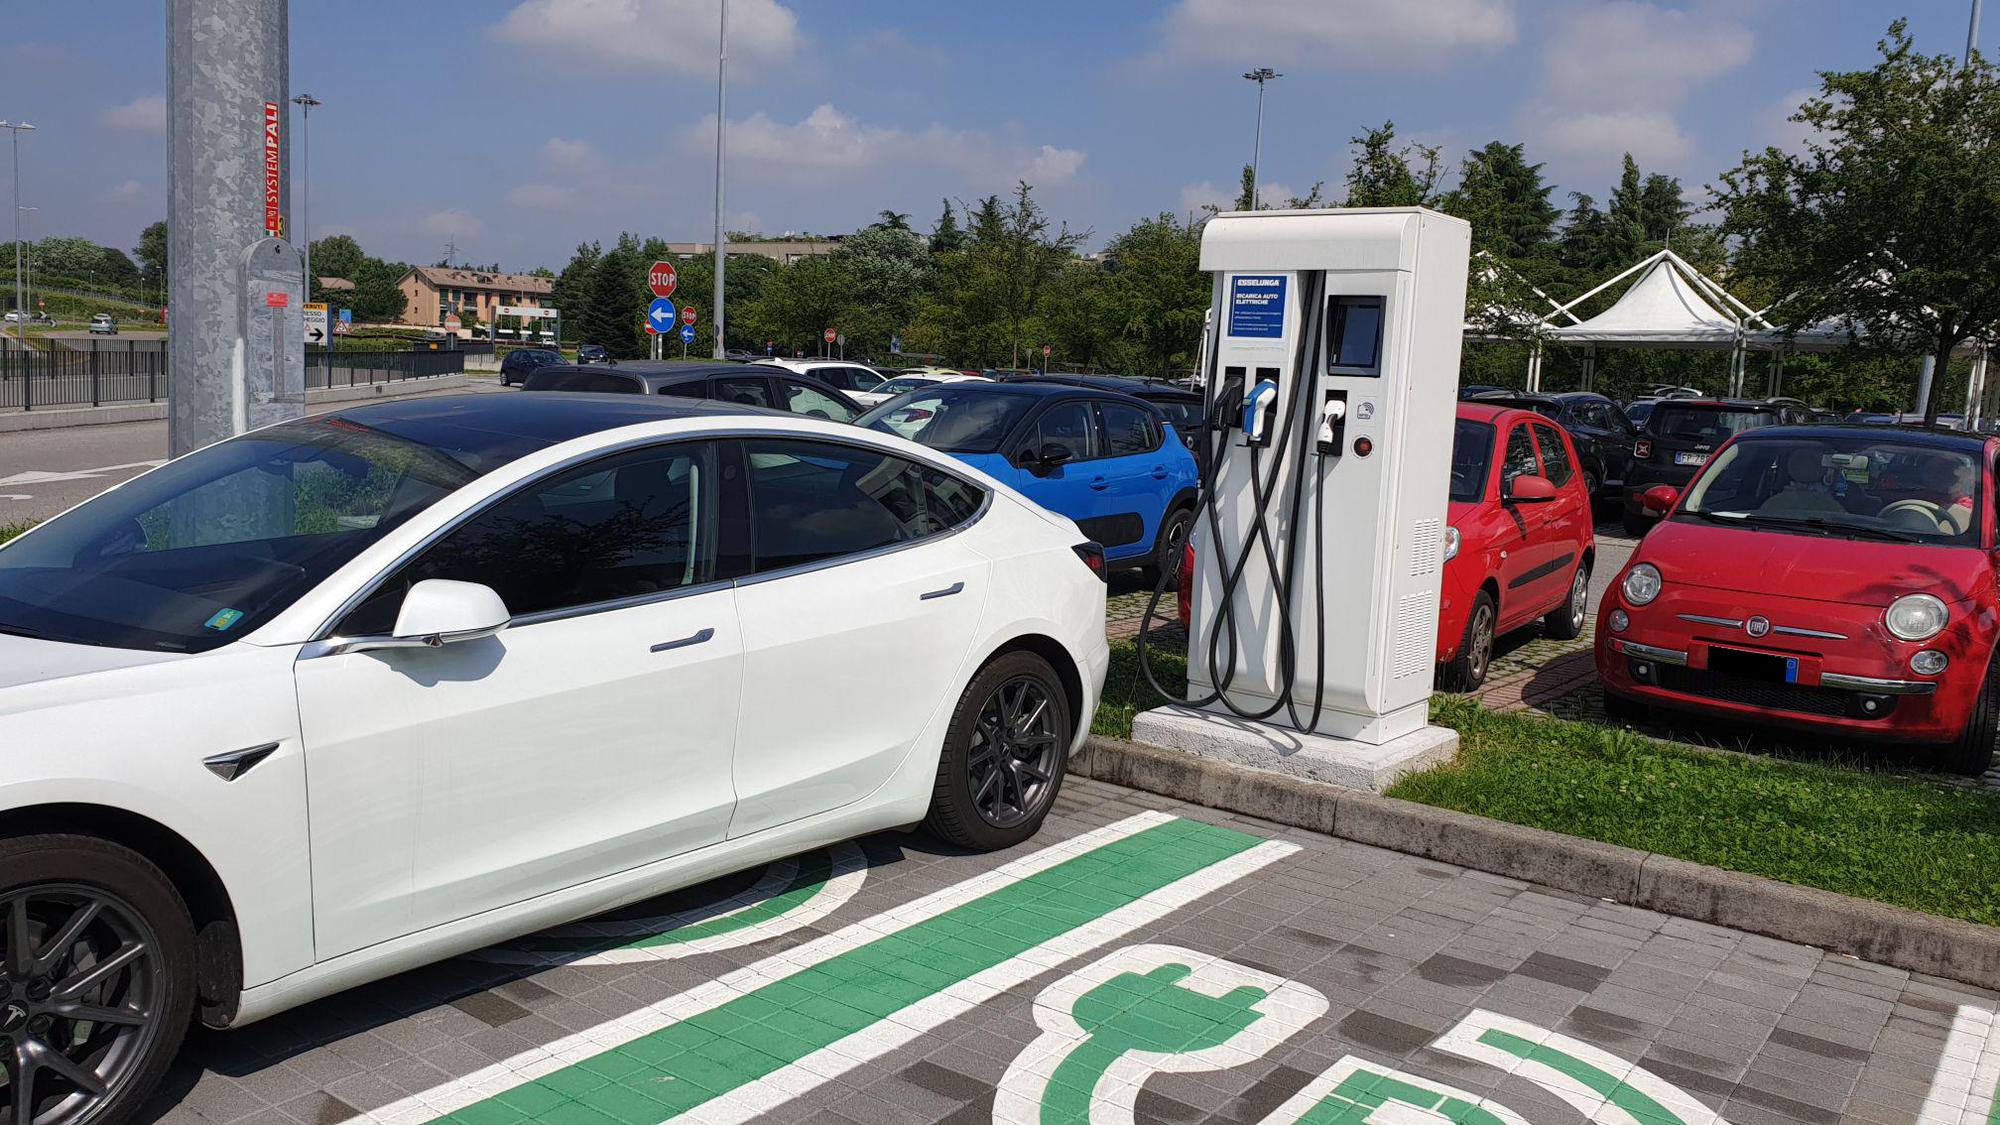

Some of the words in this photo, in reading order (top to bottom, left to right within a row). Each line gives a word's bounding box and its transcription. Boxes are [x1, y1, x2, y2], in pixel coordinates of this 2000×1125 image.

[267, 104, 278, 203] SYSTEMPALI
[651, 273, 675, 286] STOP
[1237, 279, 1279, 287] ESSELUNGA
[683, 312, 696, 320] STOP
[1751, 621, 1765, 632] FIAT
